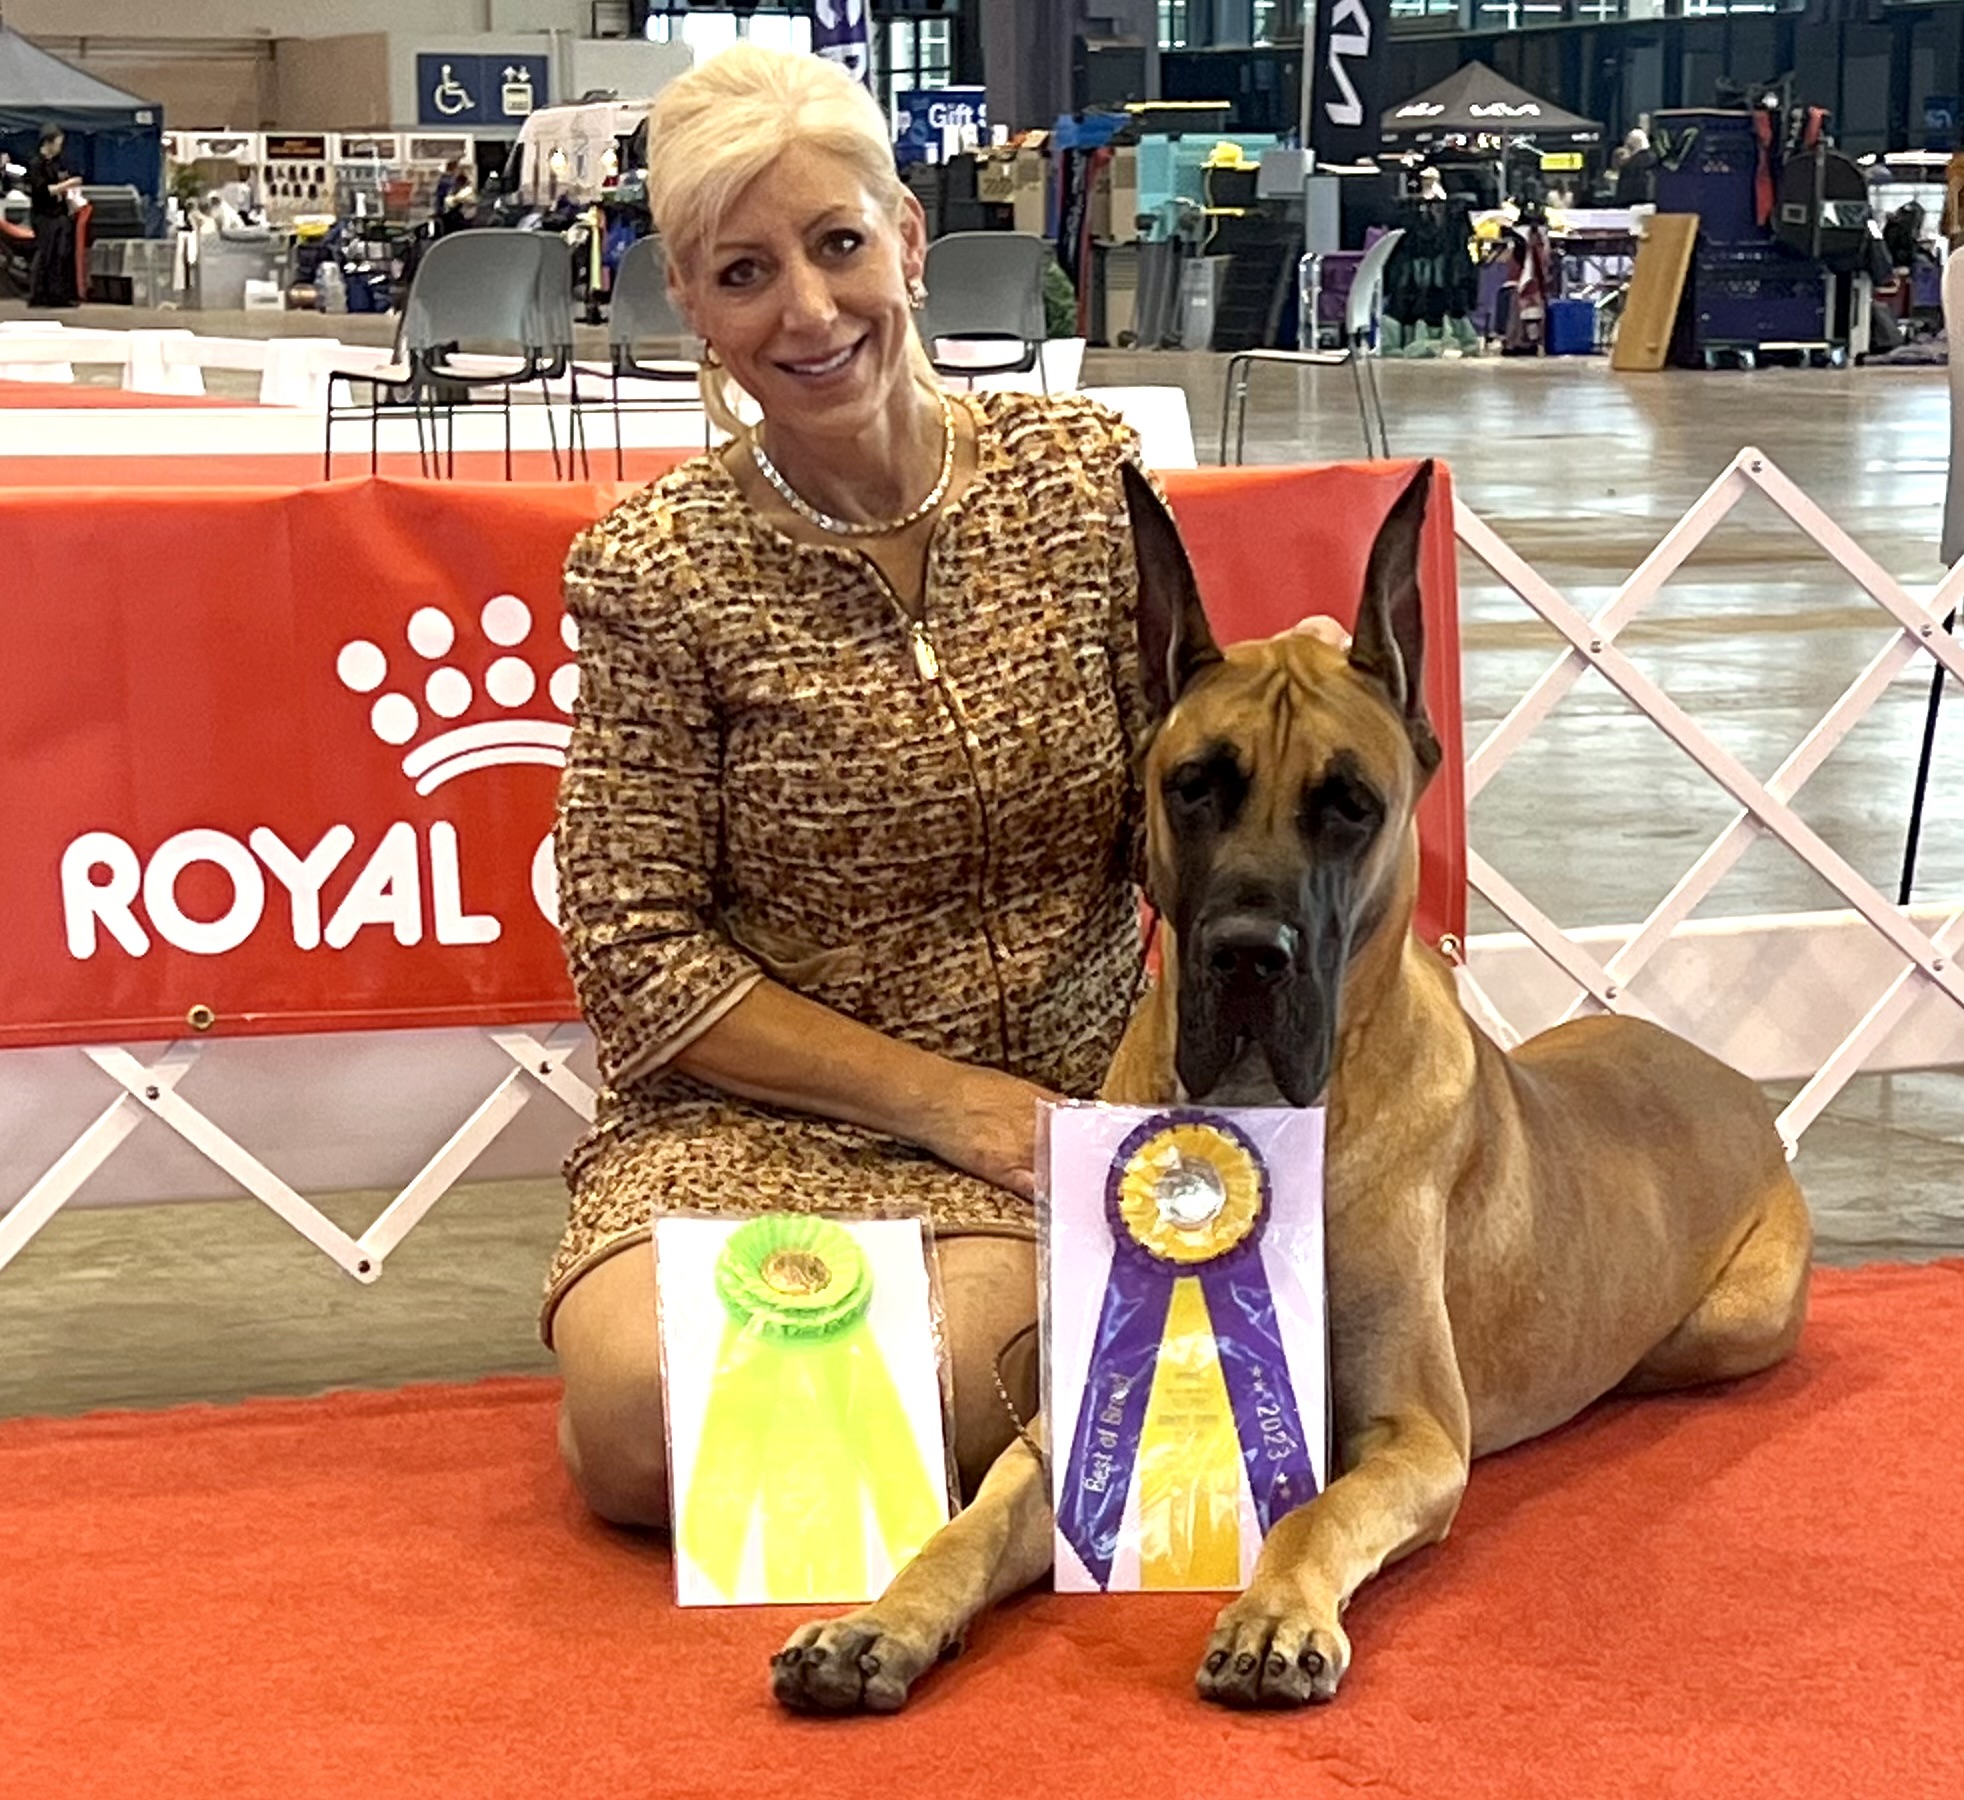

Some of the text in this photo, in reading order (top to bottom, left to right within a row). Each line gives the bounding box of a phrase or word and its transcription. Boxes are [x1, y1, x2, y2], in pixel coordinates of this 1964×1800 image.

[928, 102, 975, 128] Gift
[60, 820, 501, 960] ROYAL
[1082, 1451, 1113, 1493] Best
[1098, 1428, 1118, 1449] of
[1256, 1404, 1294, 1461] 2023
